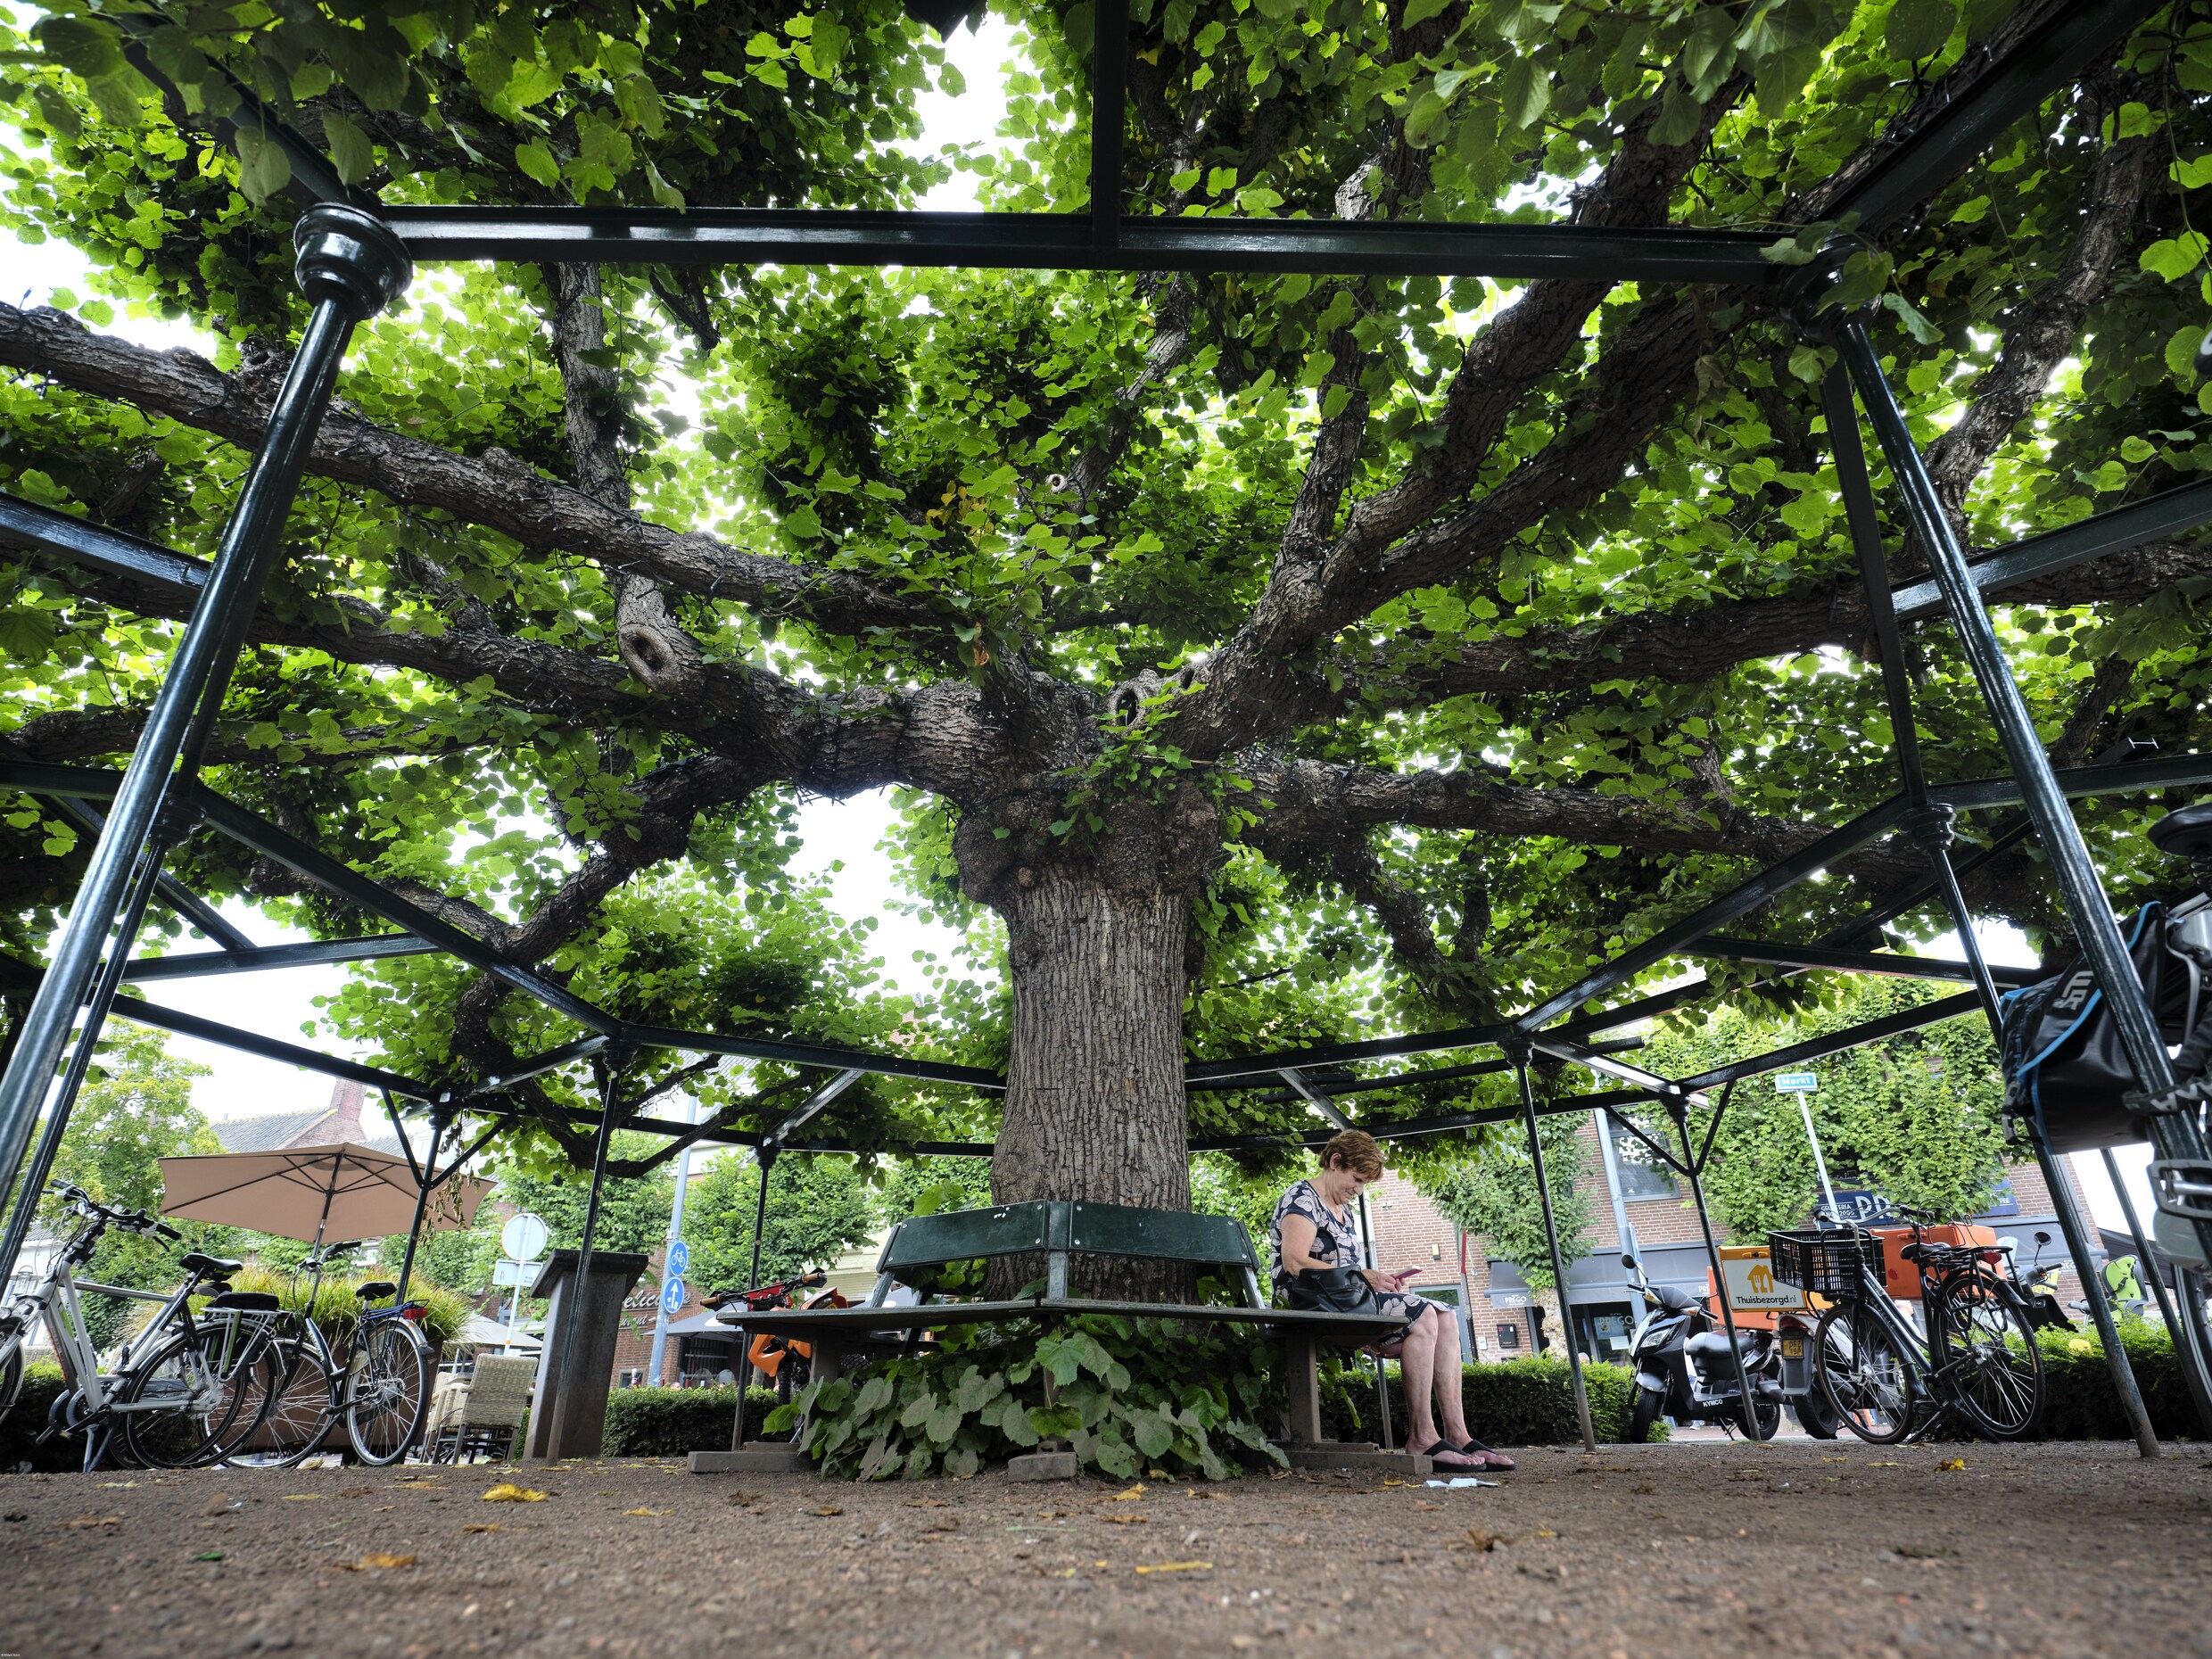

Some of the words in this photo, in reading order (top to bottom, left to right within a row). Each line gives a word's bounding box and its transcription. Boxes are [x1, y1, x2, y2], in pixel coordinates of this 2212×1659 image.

[1782, 1076, 1811, 1085] Markt
[1736, 1295, 1796, 1305] Thuisbezorgd.nl
[1703, 1399, 1723, 1407] KYMCO
